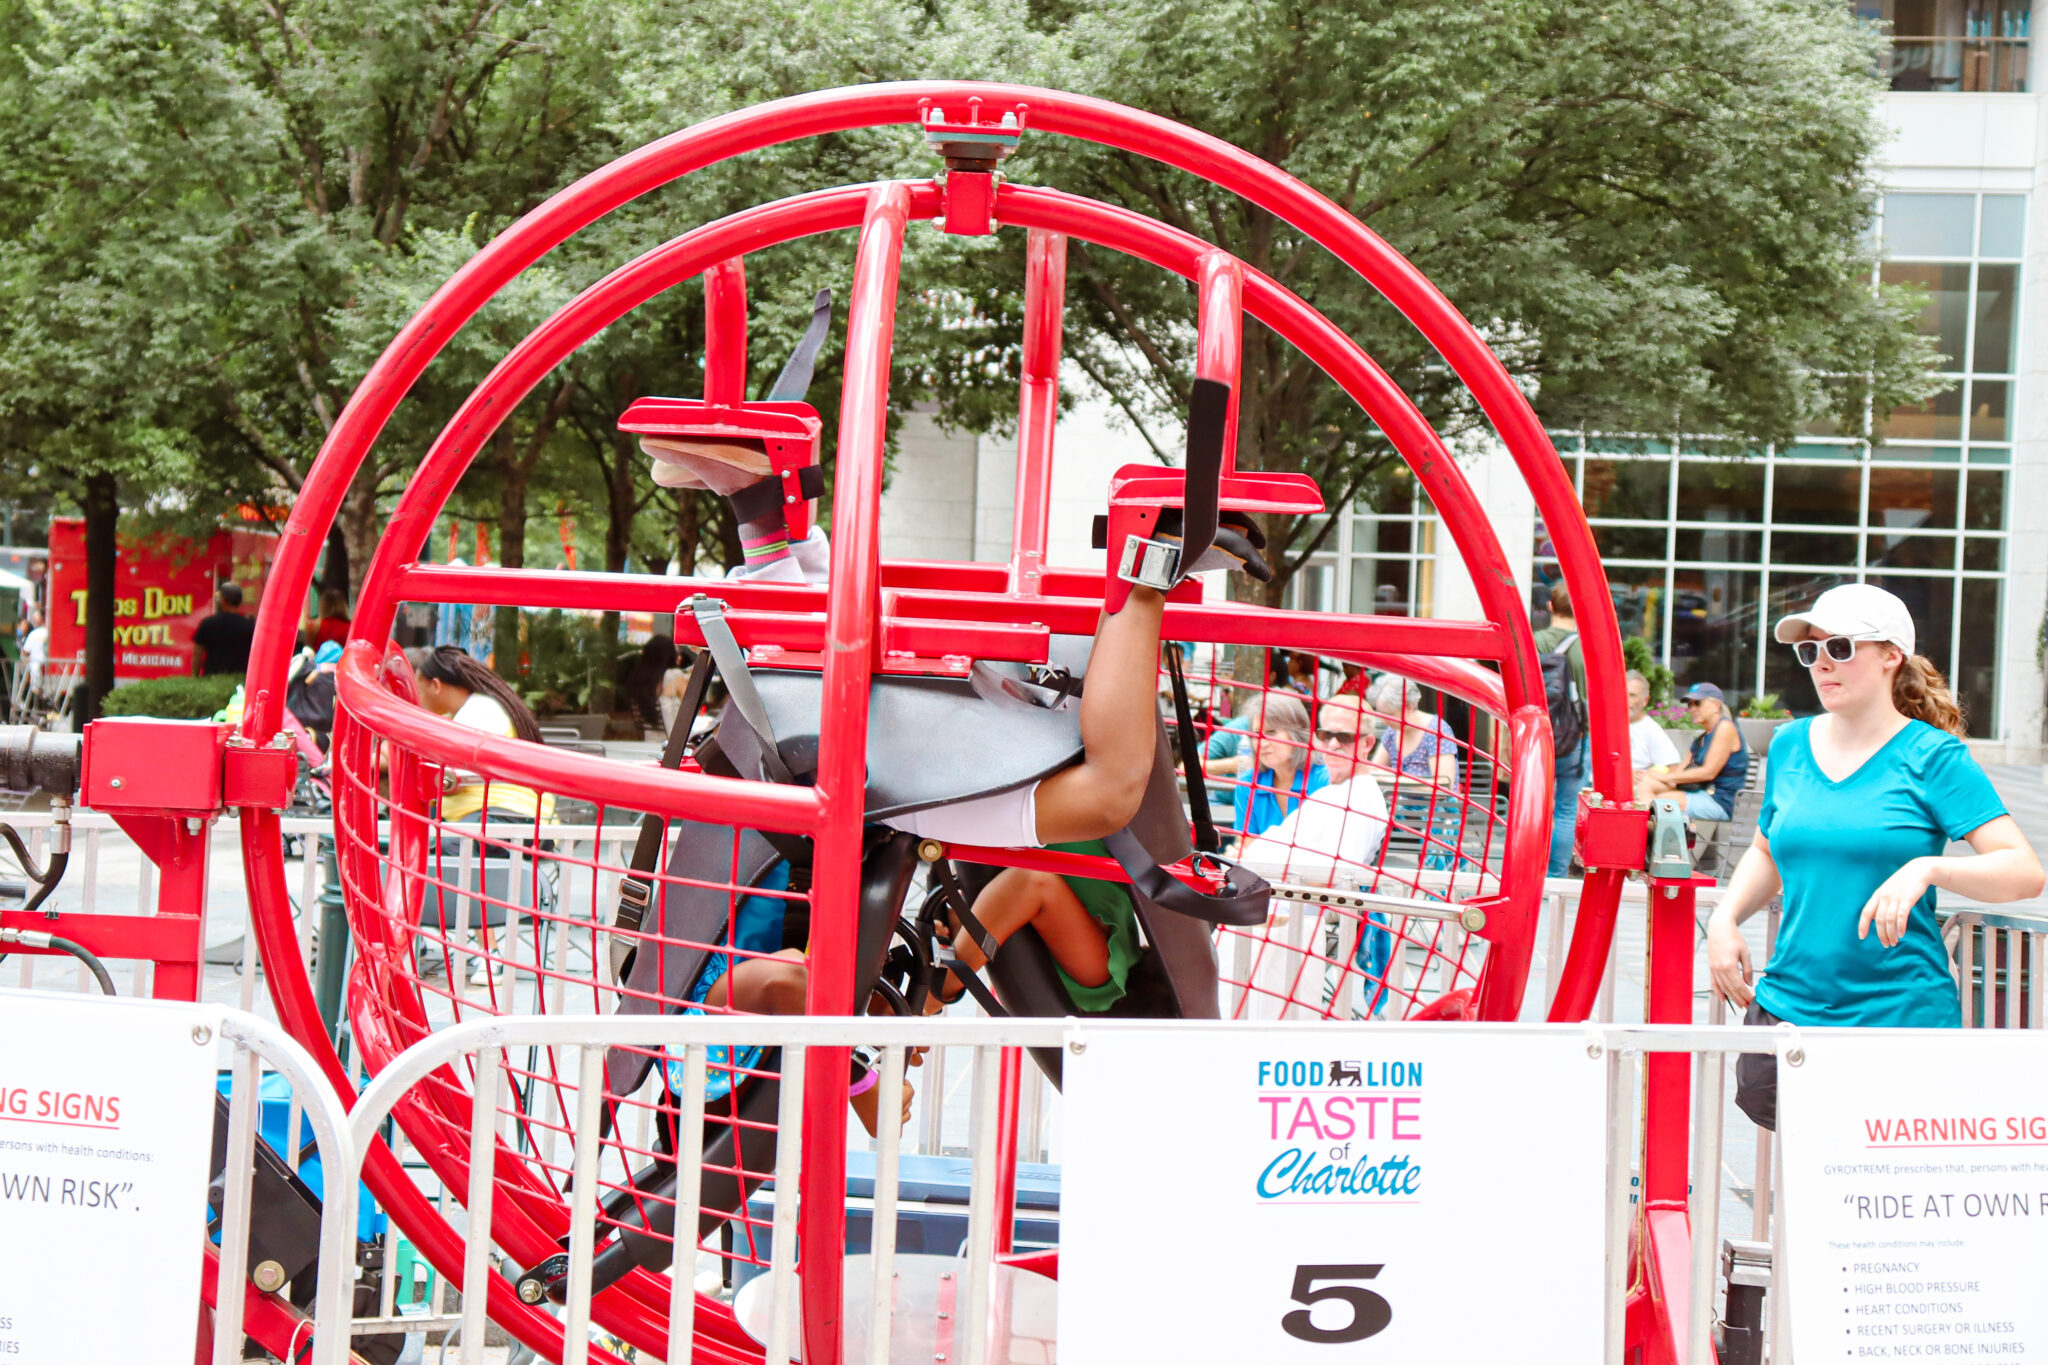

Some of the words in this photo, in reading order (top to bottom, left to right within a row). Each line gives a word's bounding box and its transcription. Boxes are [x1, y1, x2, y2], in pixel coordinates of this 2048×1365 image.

[143, 587, 193, 619] DON
[1258, 1061, 1324, 1087] FOOD
[1367, 1061, 1423, 1087] LION
[36, 1091, 120, 1123] SIGNS
[1257, 1096, 1422, 1141] TASTE
[1864, 1117, 1998, 1142] WARNING
[35, 1142, 59, 1153] with
[61, 1143, 94, 1157] health
[1328, 1142, 1352, 1161] of
[1256, 1147, 1422, 1199] Charlotte
[1824, 1164, 1891, 1175] GYROXTREME
[1894, 1162, 1943, 1176] prescribes
[1970, 1163, 2008, 1174] persons
[2010, 1161, 2031, 1173] with
[1923, 1194, 1955, 1218] AT
[1964, 1193, 2029, 1217] OWN
[1853, 1262, 1920, 1274] PREGNANCY
[1855, 1284, 1883, 1294] HIGH
[1886, 1282, 1924, 1294] BLOOD
[1927, 1281, 1981, 1293] PRESSURE
[1281, 1263, 1392, 1344] 5
[1856, 1304, 1891, 1315] HEART
[1895, 1302, 1963, 1314] CONDITIONS
[1857, 1325, 1898, 1336] RECENT
[1902, 1323, 1952, 1335] SURGERY
[1954, 1322, 1971, 1334] OR
[1974, 1321, 2015, 1333] ILLNESS
[1858, 1345, 1891, 1358] BACK,
[1894, 1345, 1922, 1356] NECK
[1925, 1344, 1941, 1355] OR
[1944, 1343, 1974, 1355] BONE
[1977, 1341, 2025, 1354] INJURIES
